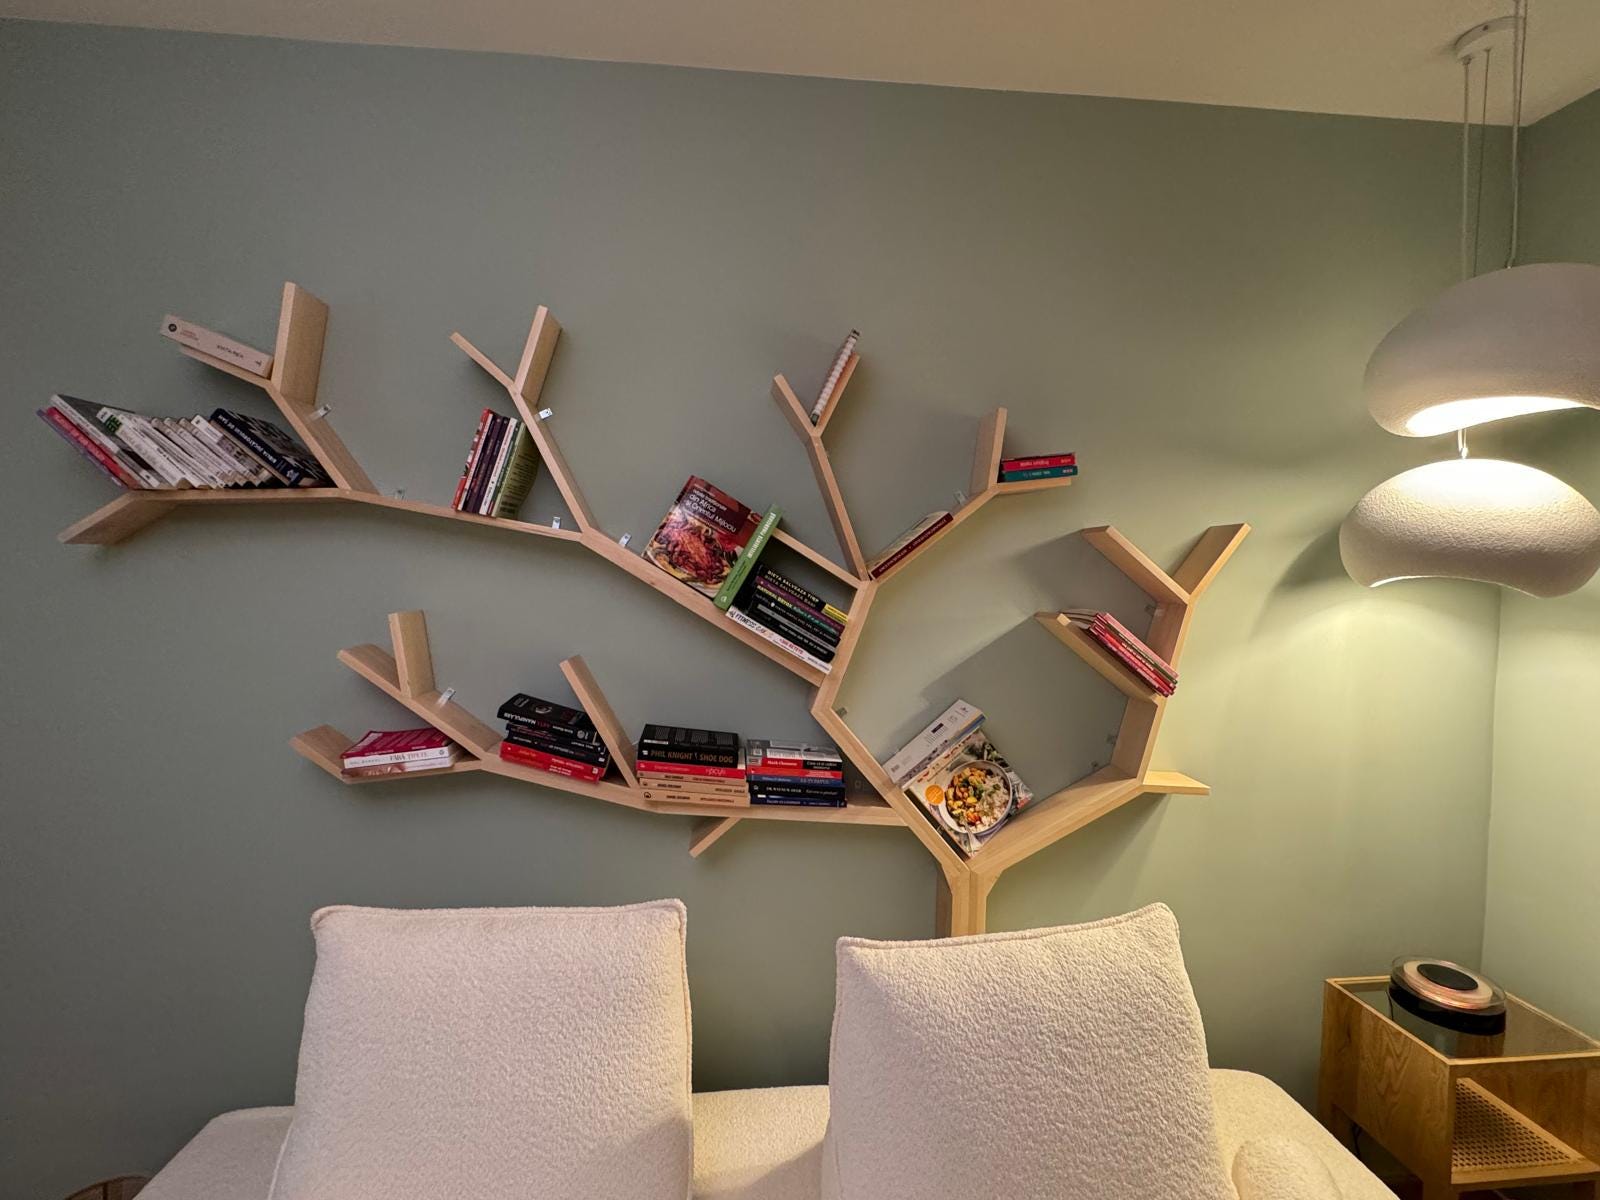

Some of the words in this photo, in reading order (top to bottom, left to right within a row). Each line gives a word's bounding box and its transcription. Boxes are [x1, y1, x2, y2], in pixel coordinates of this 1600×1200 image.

[688, 493, 699, 503] din
[698, 499, 717, 513] Africa
[755, 584, 778, 599] NATURAL
[776, 596, 793, 608] DETOX
[650, 750, 665, 758] PHIL
[666, 750, 692, 760] KNIGHT
[699, 754, 717, 762] SHOE
[718, 755, 733, 763] DOG
